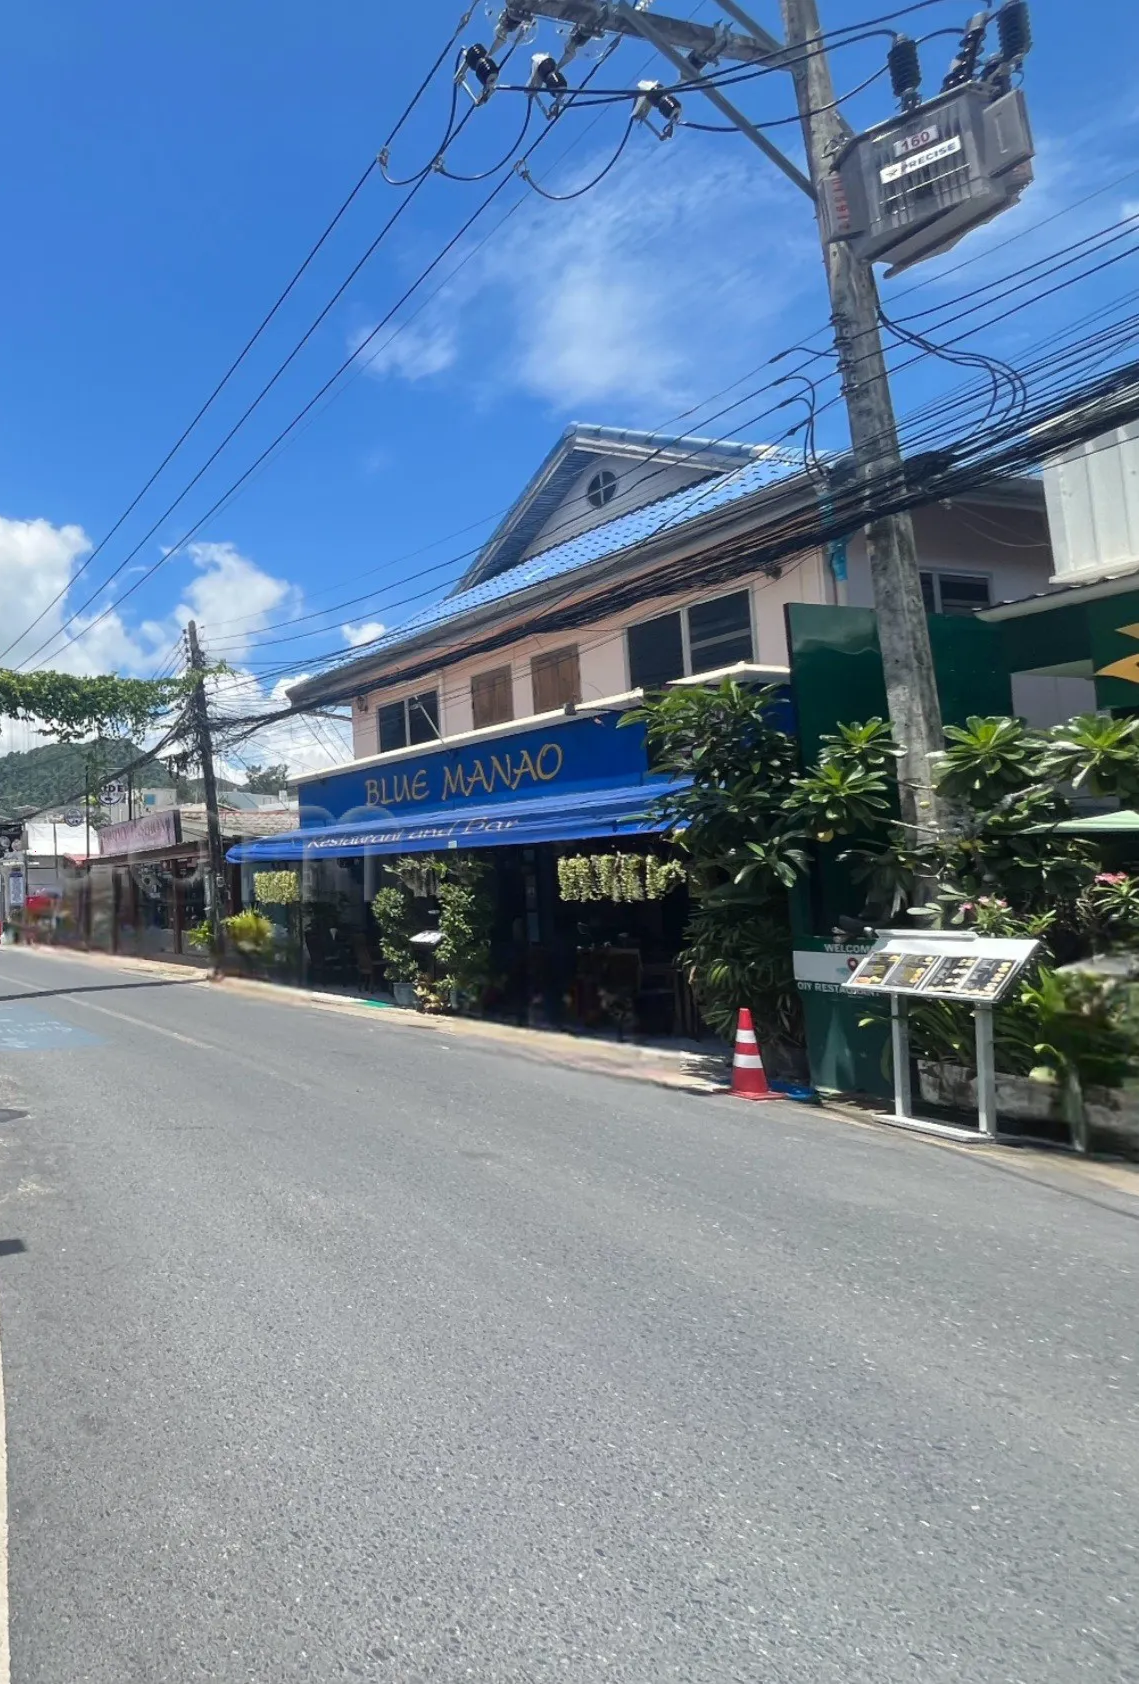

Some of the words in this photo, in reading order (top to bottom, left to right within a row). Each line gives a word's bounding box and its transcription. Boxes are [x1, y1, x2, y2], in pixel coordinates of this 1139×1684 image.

[901, 131, 930, 151] 160
[901, 142, 956, 174] PRECISE
[365, 769, 430, 807] BLUE
[441, 743, 564, 801] MANAO
[307, 829, 405, 849] Restaurant
[408, 820, 460, 840] and
[461, 816, 519, 836] Bar
[823, 943, 871, 954] WELCOM
